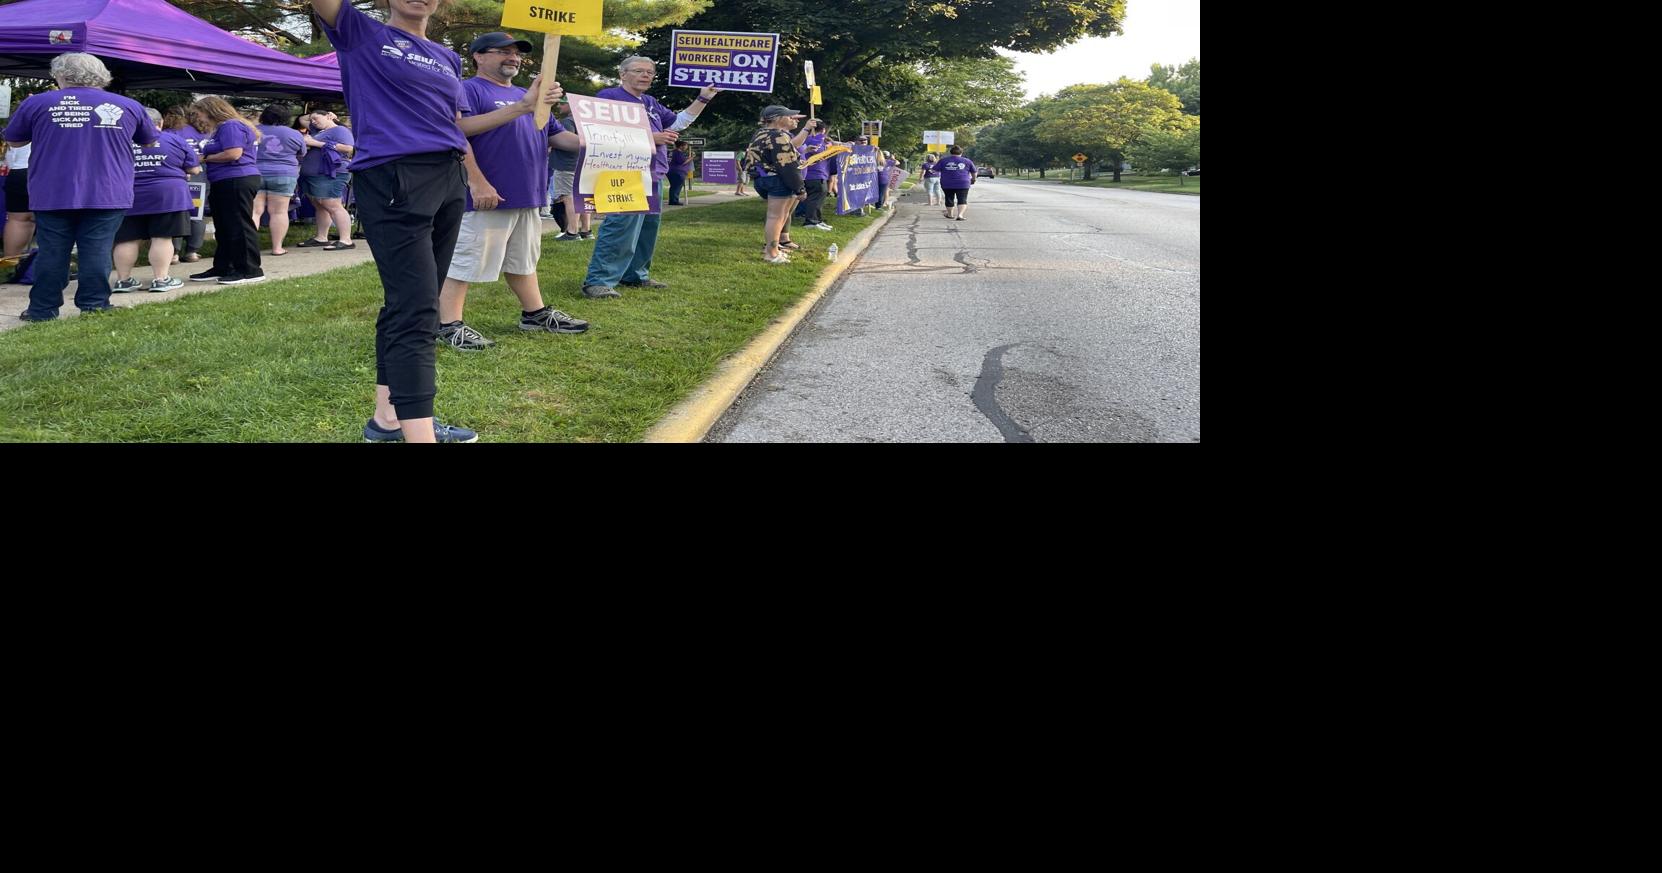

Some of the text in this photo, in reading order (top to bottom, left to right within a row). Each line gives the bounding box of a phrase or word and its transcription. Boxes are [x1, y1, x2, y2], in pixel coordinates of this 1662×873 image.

[529, 6, 577, 23] STRIKE
[678, 36, 771, 49] SEIU HEALTHCARE
[678, 53, 771, 68] WORKERS ON
[674, 67, 769, 87] STRIKE
[578, 100, 641, 125] SEIU
[588, 142, 623, 158] Invest
[610, 178, 626, 187] ULP
[607, 193, 635, 203] STRIKE
